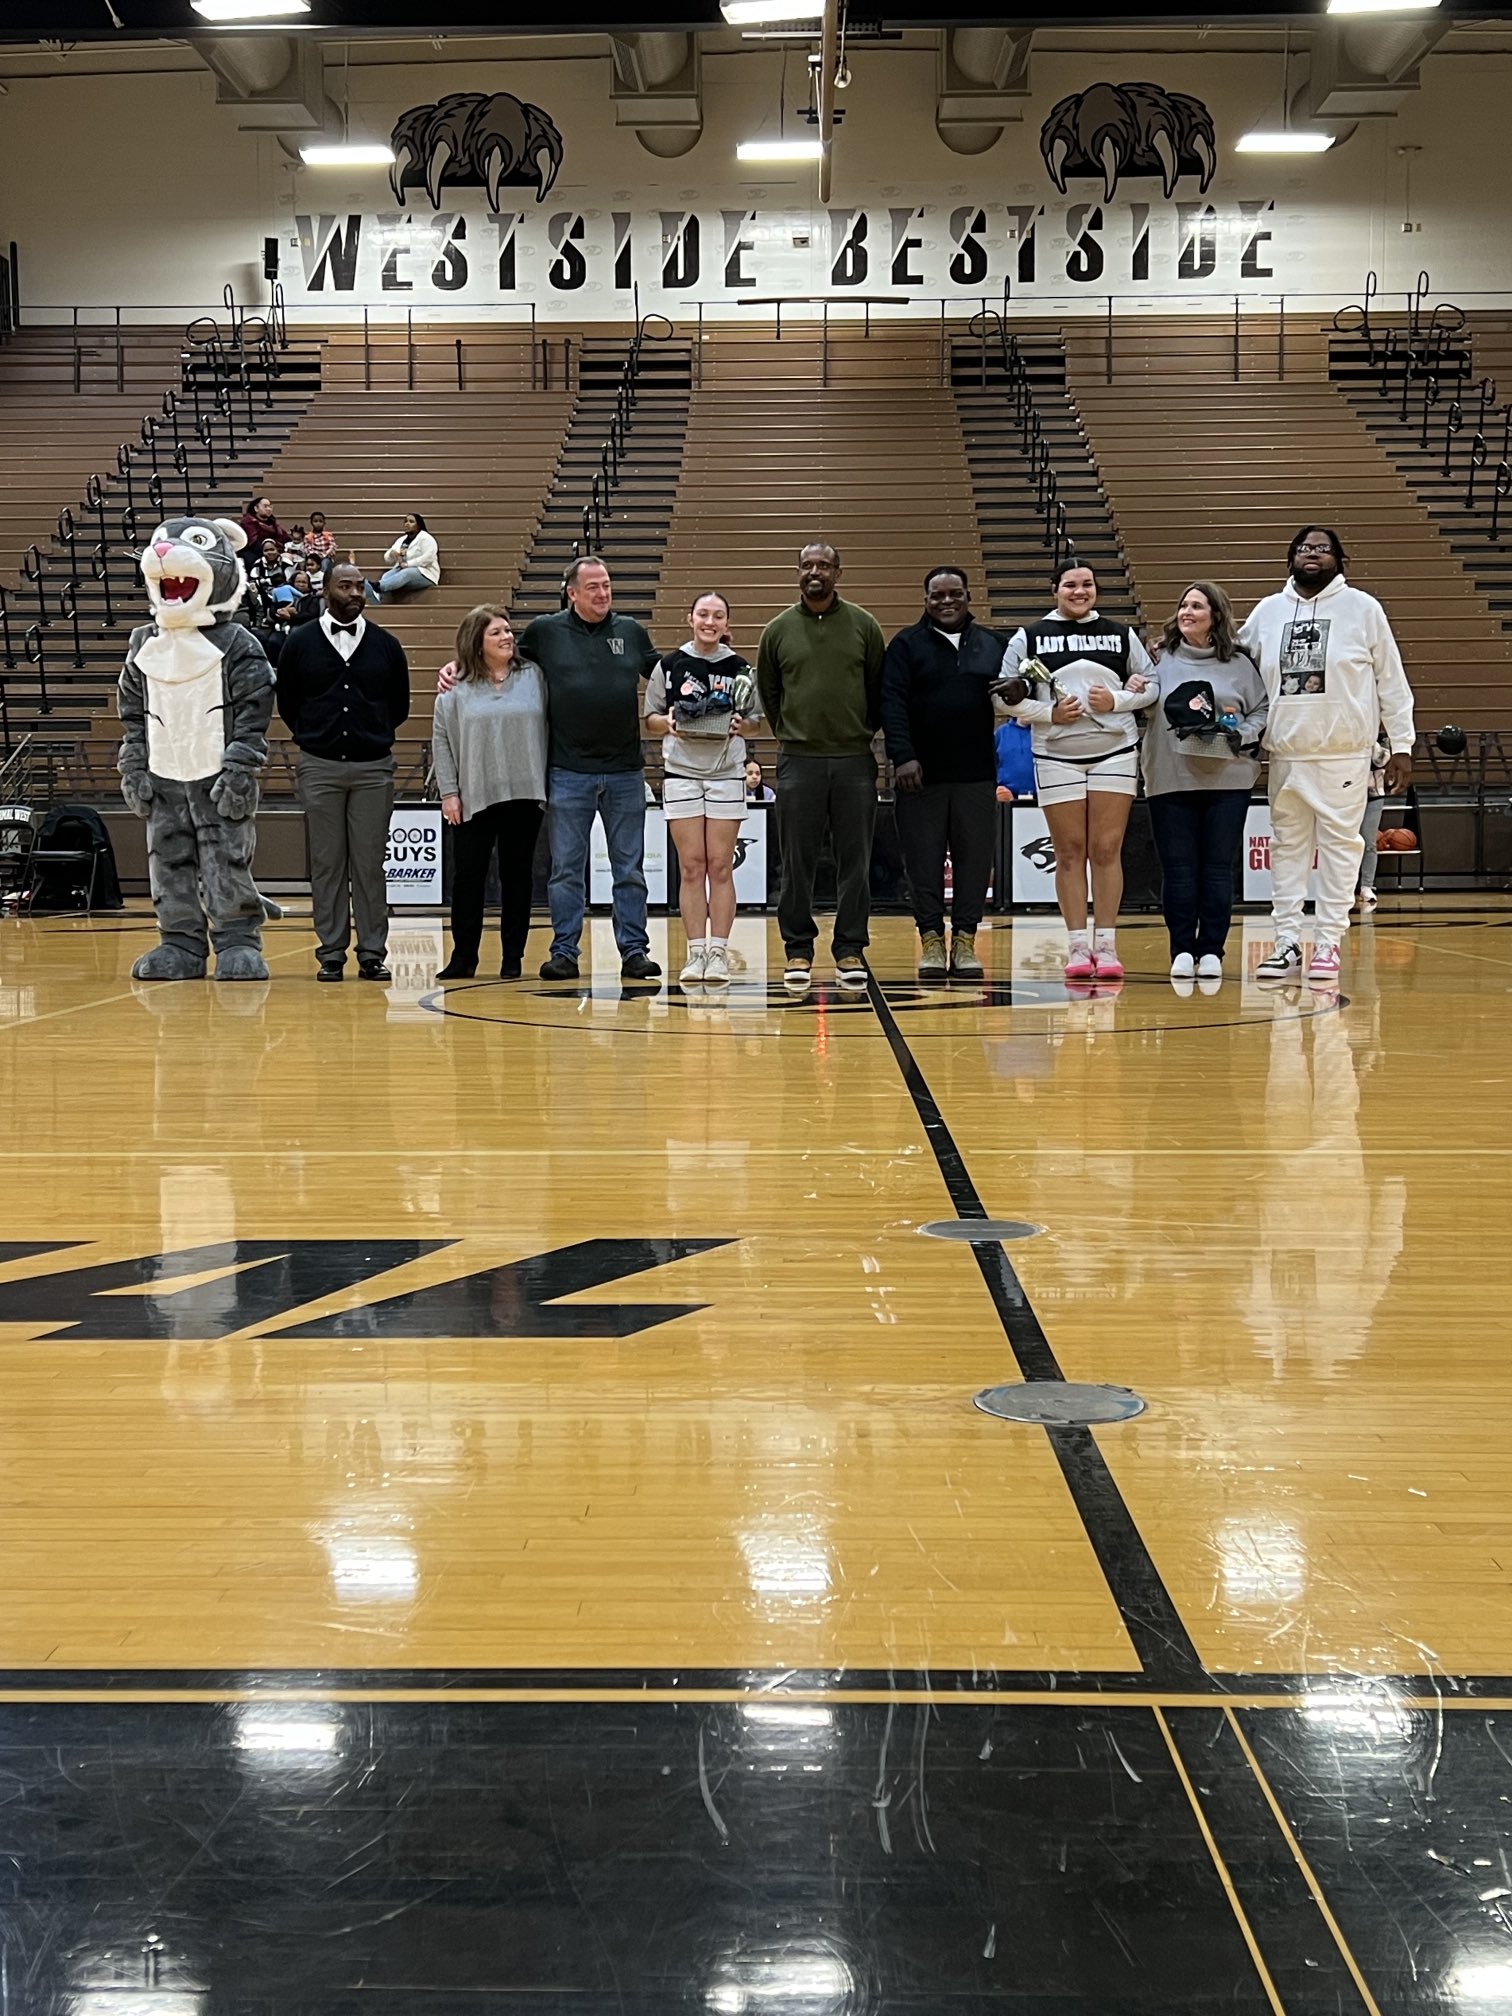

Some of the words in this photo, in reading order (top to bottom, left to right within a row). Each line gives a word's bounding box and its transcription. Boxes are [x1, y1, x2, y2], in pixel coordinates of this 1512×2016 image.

[295, 212, 757, 292] WESTSIDE
[827, 200, 1275, 286] BESTSIDE
[1035, 635, 1065, 655] LADY
[1066, 634, 1122, 654] WILDCATS
[388, 828, 436, 844] OOD
[387, 868, 436, 879] BARKER
